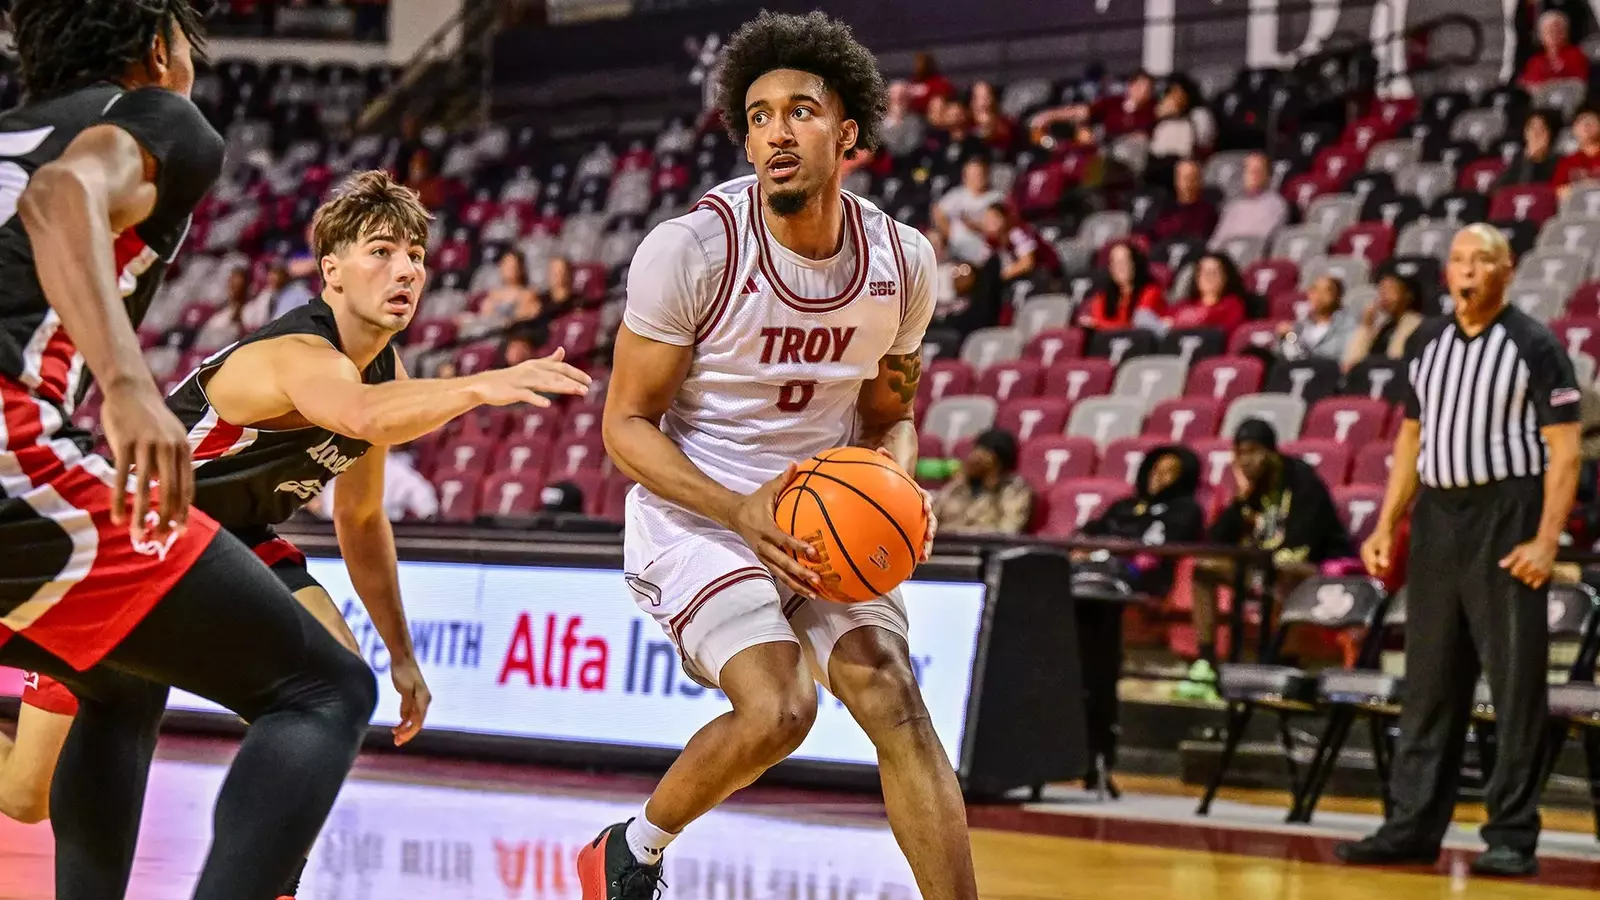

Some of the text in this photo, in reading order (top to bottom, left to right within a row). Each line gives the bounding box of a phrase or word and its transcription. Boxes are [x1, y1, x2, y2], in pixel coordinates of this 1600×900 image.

[869, 281, 896, 297] SBC
[759, 326, 857, 364] TROY
[411, 620, 484, 669] WITH
[497, 609, 611, 693] Alfa
